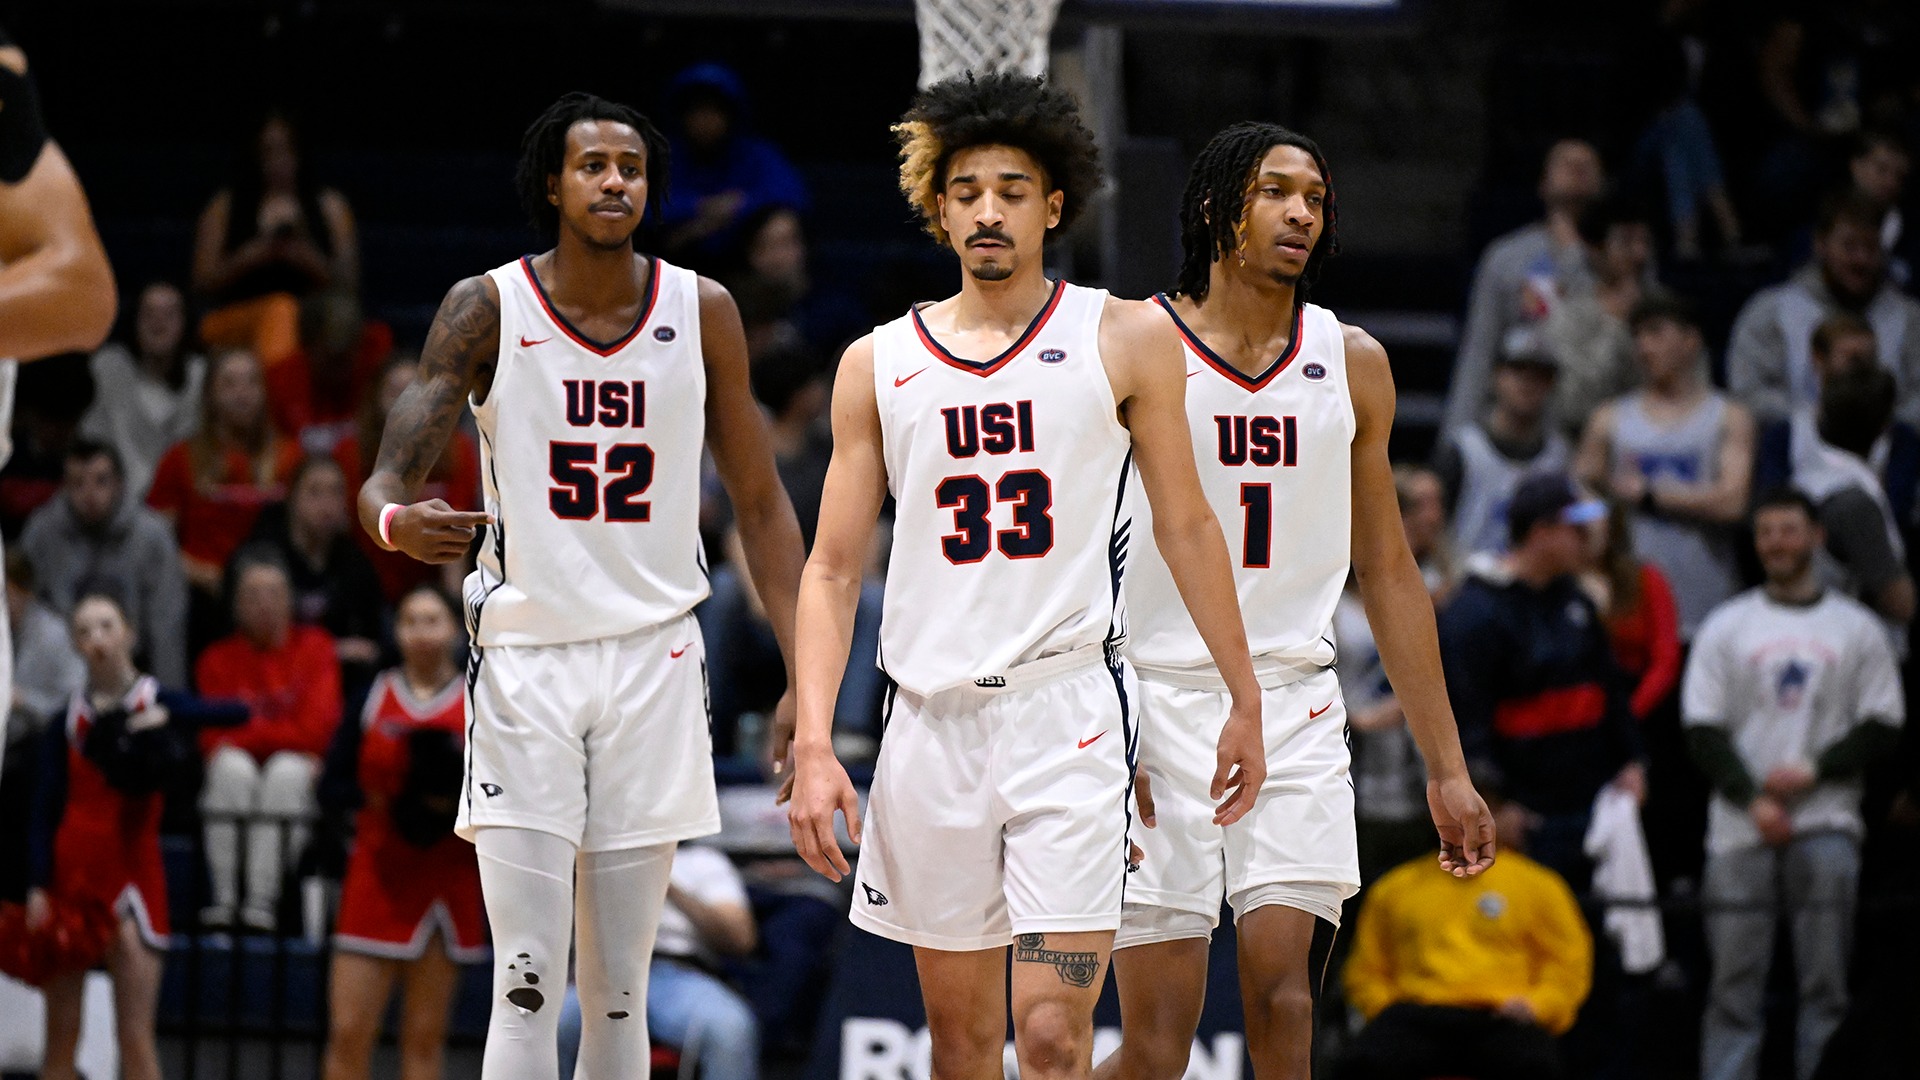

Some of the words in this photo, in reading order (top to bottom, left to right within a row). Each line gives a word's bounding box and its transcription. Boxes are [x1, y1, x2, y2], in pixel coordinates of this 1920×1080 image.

[1043, 352, 1061, 360] OVC
[562, 379, 646, 428] USI
[940, 399, 1035, 459] USI
[1213, 415, 1298, 467] USI
[548, 440, 655, 523] 52
[934, 468, 1054, 566] 33
[1240, 482, 1272, 569] 1
